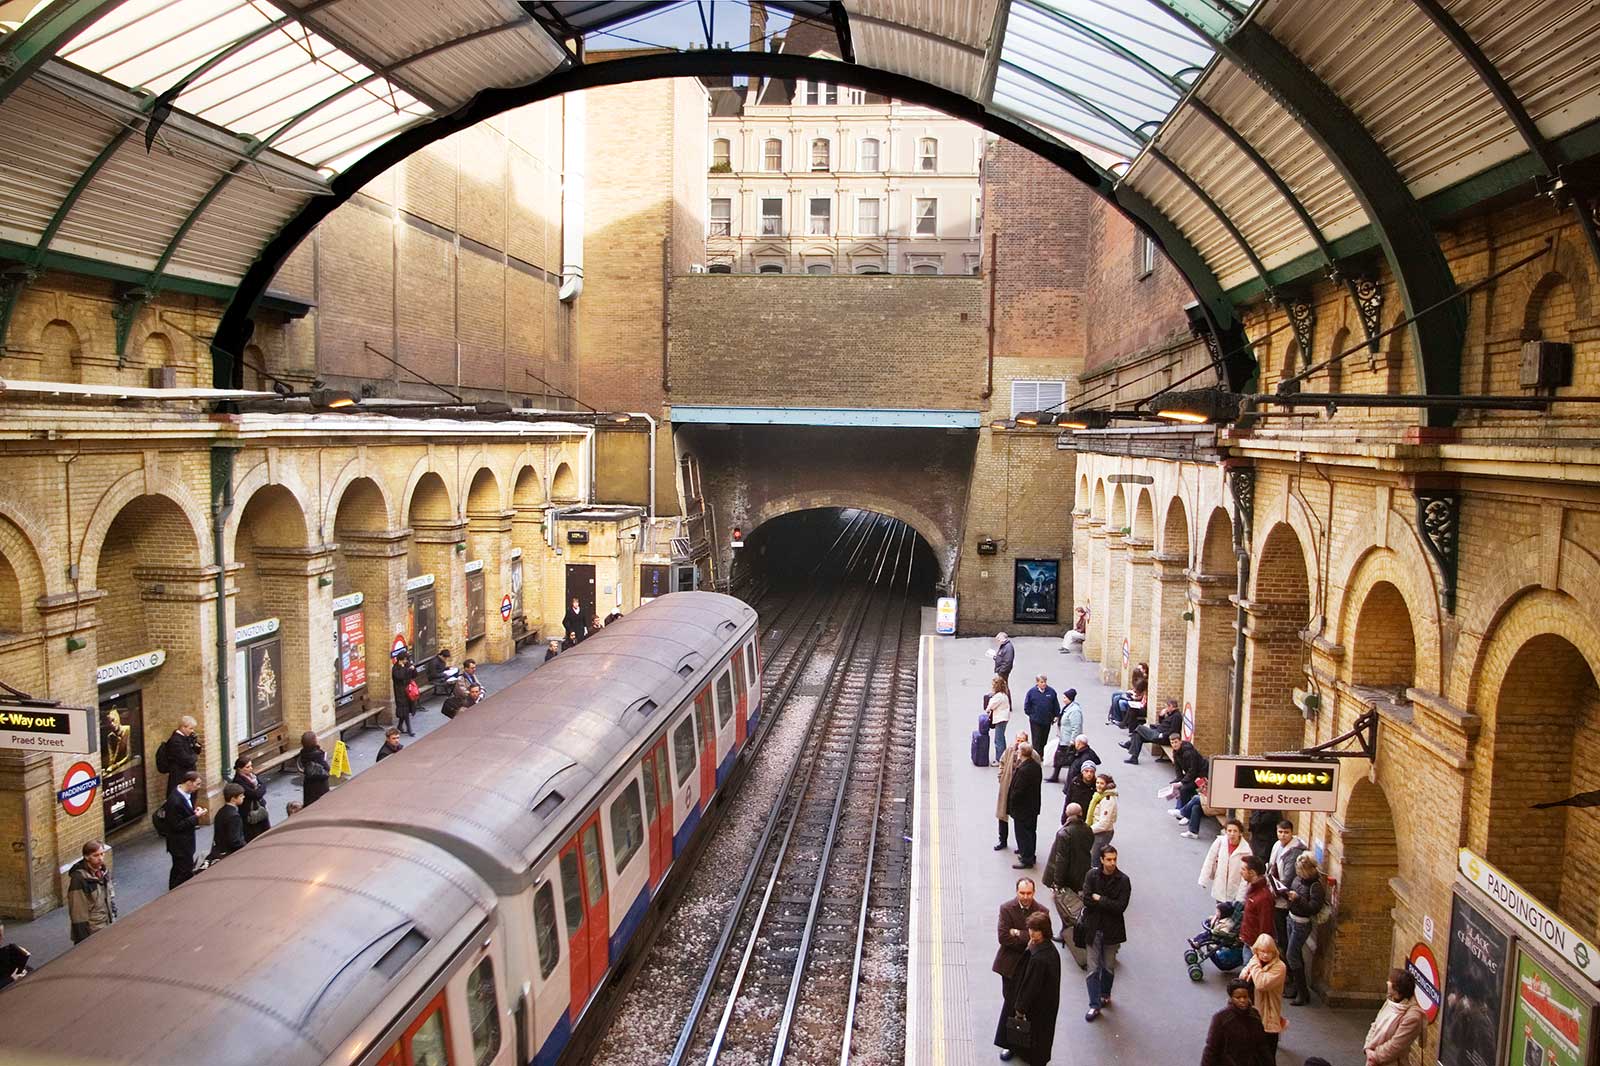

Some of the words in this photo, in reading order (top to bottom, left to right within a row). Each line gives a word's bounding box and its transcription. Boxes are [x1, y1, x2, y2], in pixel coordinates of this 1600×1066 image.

[96, 658, 146, 681] ADDINGTON
[8, 713, 34, 728] Way
[35, 717, 56, 727] out
[12, 736, 35, 745] Praed
[38, 737, 65, 747] Street
[1254, 770, 1286, 785] Way
[1287, 772, 1316, 784] out
[62, 779, 97, 799] PADDINGTON
[1242, 793, 1274, 803] Praed
[1277, 794, 1312, 805] Street
[1487, 873, 1566, 951] PADDINGTON
[1408, 964, 1440, 1005] PADDINGTON
